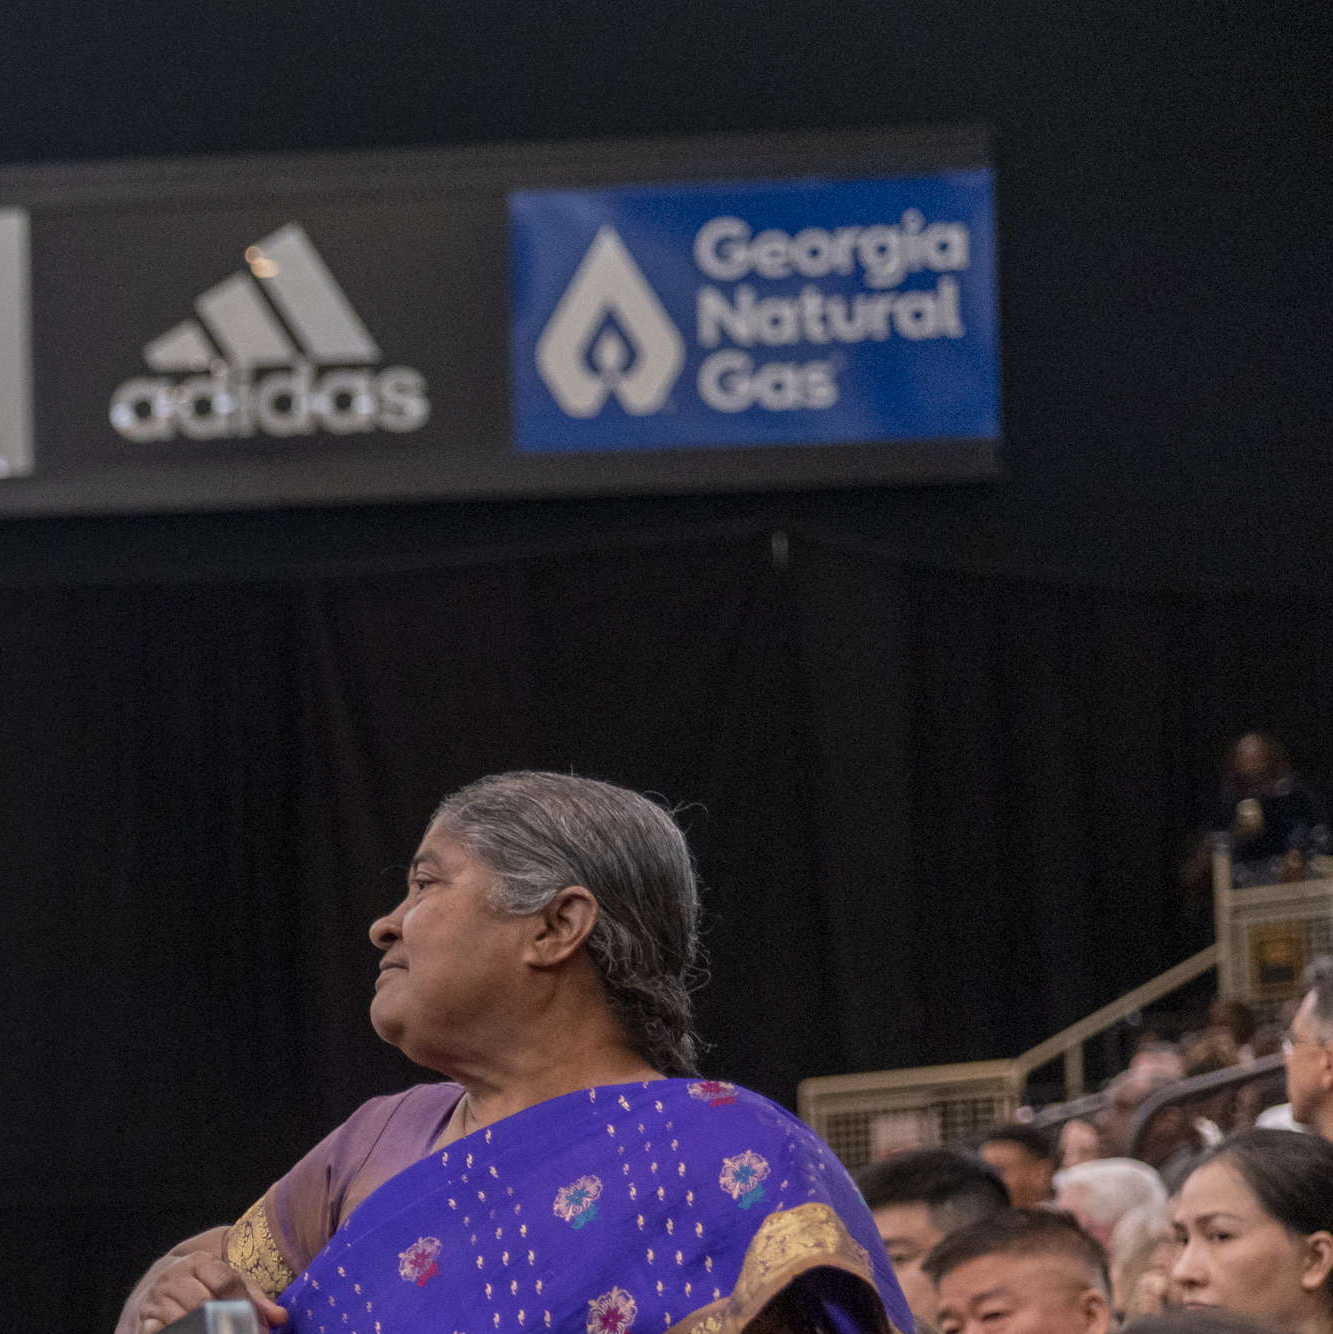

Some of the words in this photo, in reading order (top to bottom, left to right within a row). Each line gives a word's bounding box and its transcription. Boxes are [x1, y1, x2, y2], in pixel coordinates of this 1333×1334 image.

[693, 208, 970, 290] Georgia
[696, 274, 966, 348] Natural
[109, 358, 431, 443] adidas
[696, 348, 839, 414] Gas
